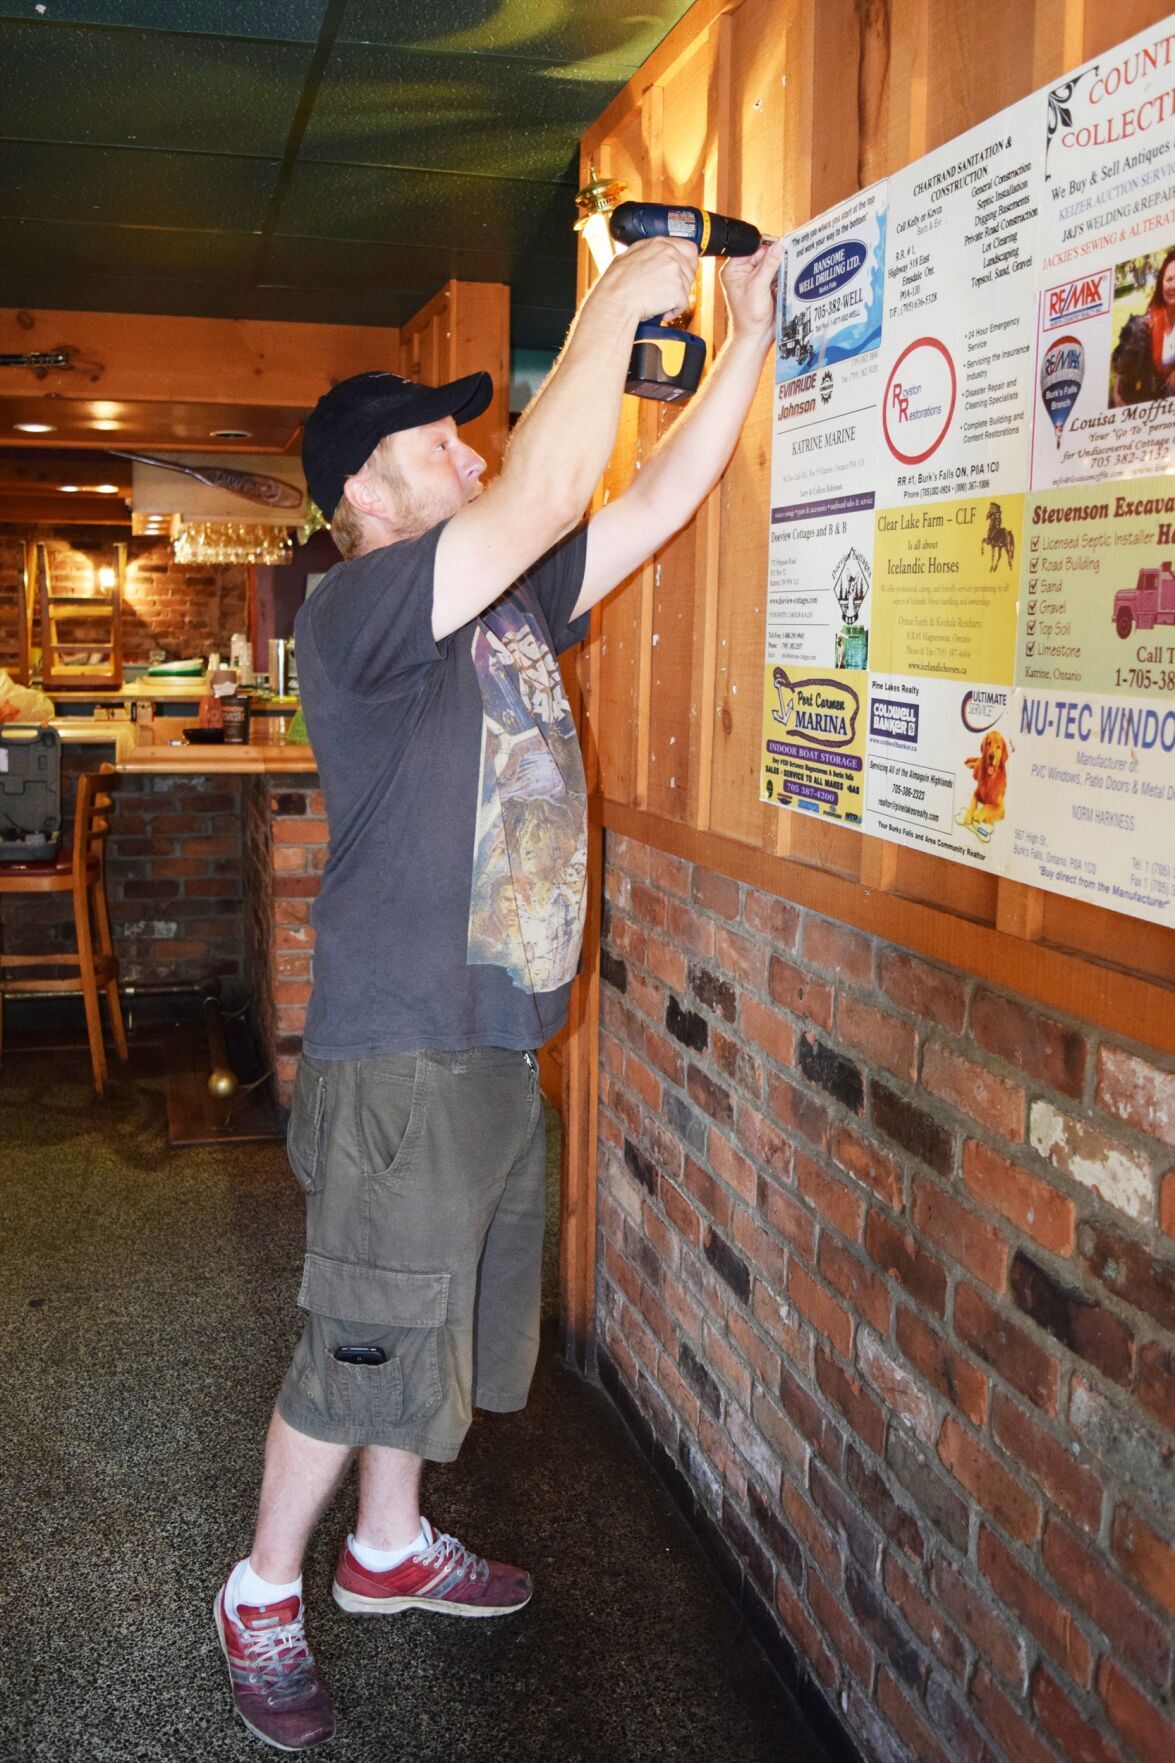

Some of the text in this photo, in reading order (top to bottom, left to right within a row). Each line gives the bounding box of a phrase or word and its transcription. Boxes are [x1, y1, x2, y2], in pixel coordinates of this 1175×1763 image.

[913, 135, 1013, 197] CHARTRAND SANITATION &
[1051, 141, 1170, 201] We Buy & Sell Antiques
[930, 165, 989, 203] CONSTRUCTION
[971, 161, 1032, 198] General Construction
[976, 180, 1028, 211] Septic Installation
[1058, 179, 1139, 222] KEIZER AUCTION
[974, 195, 1030, 227] Digging Basements
[1085, 203, 1132, 231] WELDING
[896, 214, 920, 234] Call Kelly
[964, 206, 1039, 247] Private Road Construction
[982, 231, 1018, 254] Lot Clearing
[1080, 230, 1118, 258] SEWING
[813, 248, 845, 275] RANSOME
[983, 246, 1020, 269] Landscaping
[1012, 255, 1033, 273] Gravel
[798, 255, 861, 294] WELL DRILLING LTD.
[1049, 276, 1104, 318] RE/MAX
[968, 317, 1020, 340] 24 Hour Emergency
[966, 344, 1030, 370] Servicing the Insurance
[967, 340, 987, 353] Service
[1045, 349, 1081, 376] RE/MAX
[778, 373, 817, 400] EVINRUDE
[966, 368, 988, 382] Industry
[965, 377, 1017, 399] Disaster Repair and
[1045, 384, 1079, 401] Burk's Falls
[777, 398, 816, 421] Johnson
[898, 398, 942, 424] Restorations
[965, 391, 1019, 412] Cleaning Specialists
[1050, 398, 1071, 412] Branch
[963, 411, 1024, 432] Complete Building and
[1069, 413, 1117, 433] Louisa
[791, 425, 856, 456] KATRINE MARINE
[963, 426, 1020, 444] Content Restorations
[1090, 455, 1110, 470] 705
[877, 506, 977, 532] Clear Lake Farm CLF
[1032, 501, 1109, 526] Stevenson
[771, 521, 847, 543] Doeview Cottages and B & B
[1042, 531, 1155, 553] Licensed Septic Installer
[887, 557, 960, 575] Icelandic Horses
[1040, 556, 1101, 574] Road Building
[1040, 579, 1063, 594] Sand
[1039, 600, 1067, 615] Gravel
[1039, 620, 1071, 640] Top Soil
[1037, 641, 1081, 658] Limestone
[1136, 646, 1163, 664] Call
[1053, 668, 1082, 682] Ontario
[871, 680, 920, 697] Pine Lakes Realty
[972, 690, 1007, 706] ULTIMATE
[797, 691, 846, 711] Port Carmen
[967, 702, 993, 717] SERVICE
[794, 710, 848, 736] MARINA
[1019, 698, 1093, 743] NU-TEC
[769, 742, 858, 769] INDOOR BOAT STORAGE
[1075, 751, 1128, 773] Manufacturer
[765, 764, 844, 791] SALES SERVICE TO ALL MAKES
[869, 760, 889, 775] Servicing
[895, 767, 901, 776] of
[901, 768, 909, 779] the
[908, 771, 930, 784] Almaguin
[930, 774, 953, 789] Highlands
[1031, 763, 1047, 779] PVC
[1083, 773, 1104, 790] Patio
[1105, 776, 1130, 794] Doors
[1131, 780, 1140, 795] &
[1140, 781, 1165, 800] Metal
[800, 785, 835, 801] 387-4200
[1072, 804, 1136, 832] NORM HARKNESS
[878, 820, 986, 861] Your Burks Falls and Area Community Realtor
[1055, 868, 1077, 885] direct
[1077, 874, 1096, 891] from
[1097, 879, 1110, 894] the
